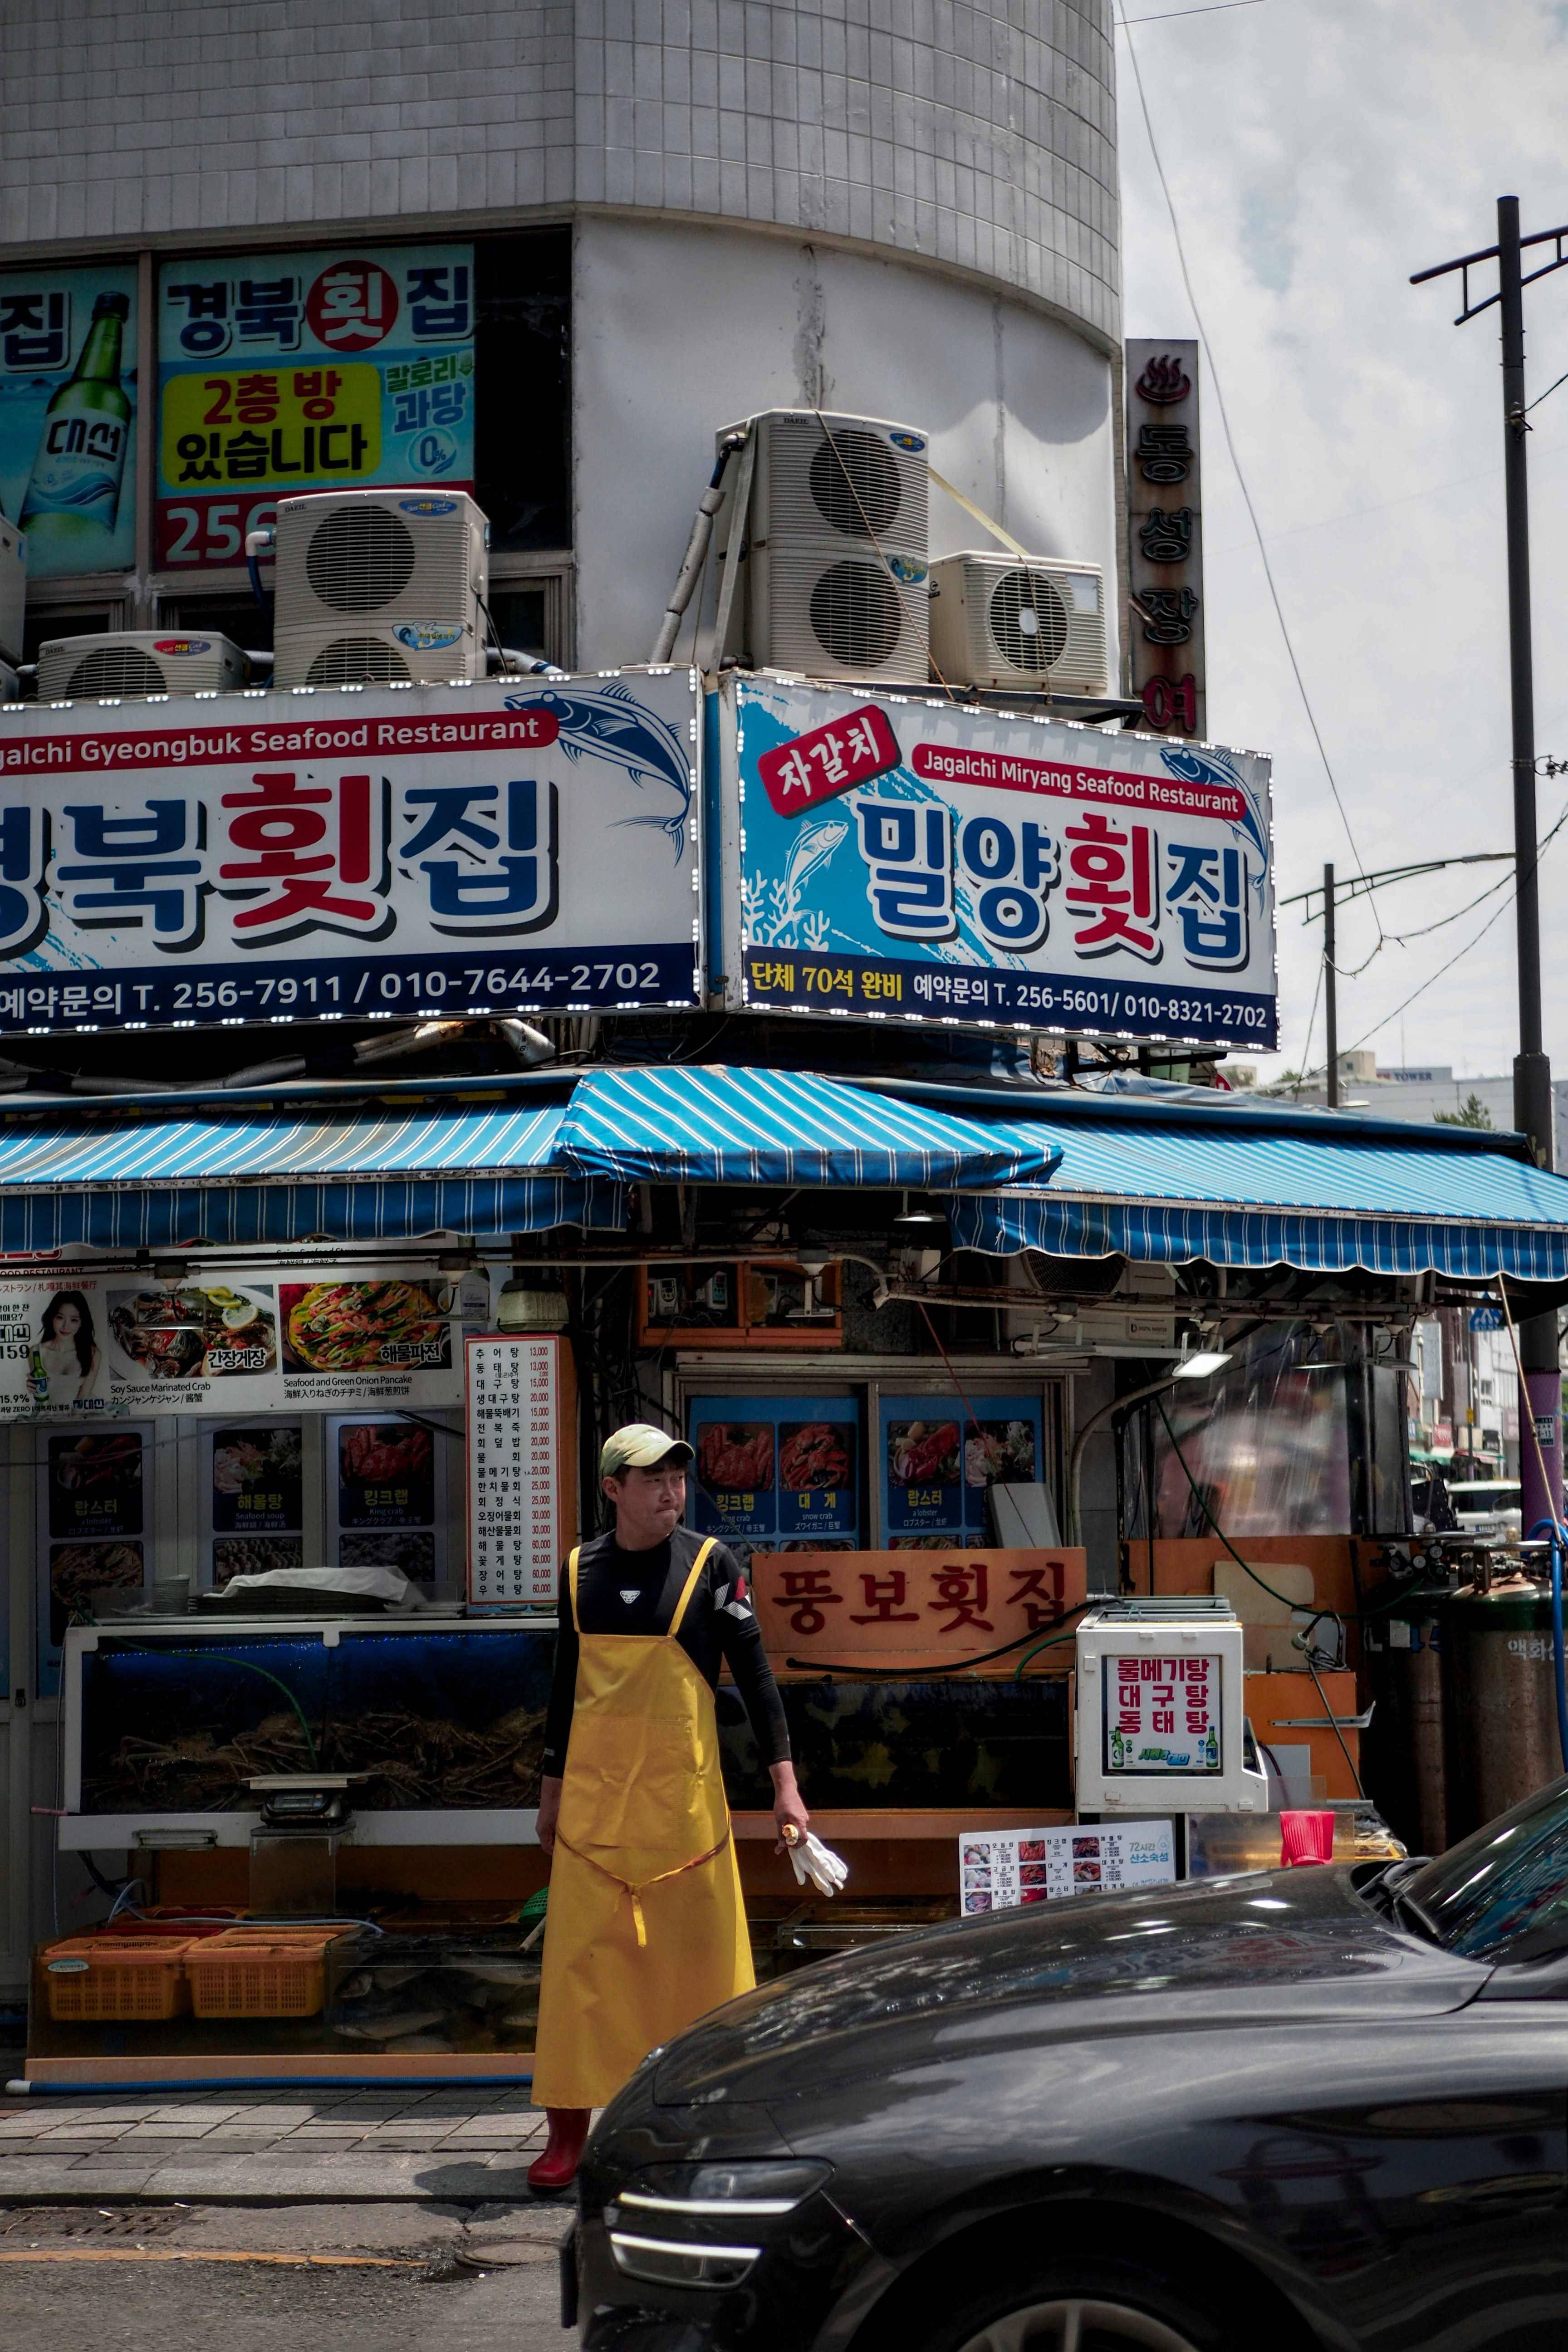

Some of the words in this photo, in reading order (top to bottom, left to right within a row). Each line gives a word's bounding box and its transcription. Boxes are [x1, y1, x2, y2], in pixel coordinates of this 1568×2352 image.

[167, 265, 470, 352] 경북횟집
[1, 293, 64, 367] 집
[386, 354, 456, 394] 칼로리
[204, 373, 280, 425] 2층
[294, 371, 342, 421] 방
[394, 382, 466, 433] 과당
[176, 423, 367, 483] 있습니다
[284, 504, 307, 513] DAEIL
[0, 741, 72, 768] alchi
[80, 732, 242, 766] Gyeongbuk
[250, 725, 368, 752] Seafood
[377, 718, 539, 745] Restaurant
[777, 716, 881, 797] 자갈치
[924, 750, 997, 779] Jagalchi
[1001, 762, 1072, 794] Miryang
[1076, 773, 1145, 799] Seafood
[1149, 783, 1239, 813] Restaurant
[0, 772, 537, 940] 북횟집
[857, 802, 1241, 959] 밀양횟집
[0, 984, 121, 1019] 예약문의
[132, 985, 160, 1011] T.
[173, 976, 341, 1009] 256-7911
[380, 962, 661, 998] 010-7644-2702
[750, 961, 794, 992] 단체
[802, 968, 854, 998] 70석
[861, 970, 902, 1002] 완비
[913, 973, 989, 1006] 예약문의
[994, 983, 1010, 1007] T.
[1124, 996, 1267, 1028] 010-8321-2702
[1394, 1071, 1432, 1081] TOWER
[381, 1343, 441, 1363] 해물파전
[530, 1347, 548, 1357] 13,000
[208, 1349, 266, 1367] 간장게장
[530, 1362, 548, 1371] 13,000
[284, 1378, 314, 1387] Seafood
[316, 1377, 330, 1386] and
[332, 1377, 354, 1386] Green
[356, 1376, 379, 1385] Onion
[381, 1375, 412, 1384] Pancake
[530, 1378, 548, 1387] 15,000
[111, 1385, 125, 1395] Soy
[151, 1382, 191, 1392] Marinated
[192, 1382, 211, 1391] Crab
[530, 1393, 549, 1403] 20,000
[531, 1407, 549, 1417] 15,000
[531, 1422, 549, 1432] 20,000
[531, 1436, 549, 1447] 20,000
[531, 1451, 549, 1461] 20,000
[531, 1466, 549, 1476] 20,000
[532, 1481, 549, 1491] 25,000
[237, 1493, 283, 1510] 해물탕
[363, 1488, 408, 1506] 킹크랩
[532, 1495, 550, 1505] 25,000
[716, 1493, 755, 1512] 킹크랩
[907, 1489, 942, 1507] 랍스터
[74, 1498, 118, 1516] 랍스터
[369, 1508, 386, 1516] King
[235, 1512, 265, 1520] Seafood
[532, 1510, 550, 1520] 30,000
[736, 1514, 751, 1522] crab
[917, 1509, 937, 1517] lobster
[903, 1518, 931, 1527] ロブスター
[532, 1525, 550, 1535] 30,000
[532, 1540, 550, 1550] 60,000
[532, 1554, 550, 1564] 60,000
[532, 1569, 551, 1579] 60,000
[533, 1584, 551, 1594] 60,000
[1117, 1658, 1210, 1682] 물메기탕
[1130, 1852, 1169, 1864] 산소숙성
